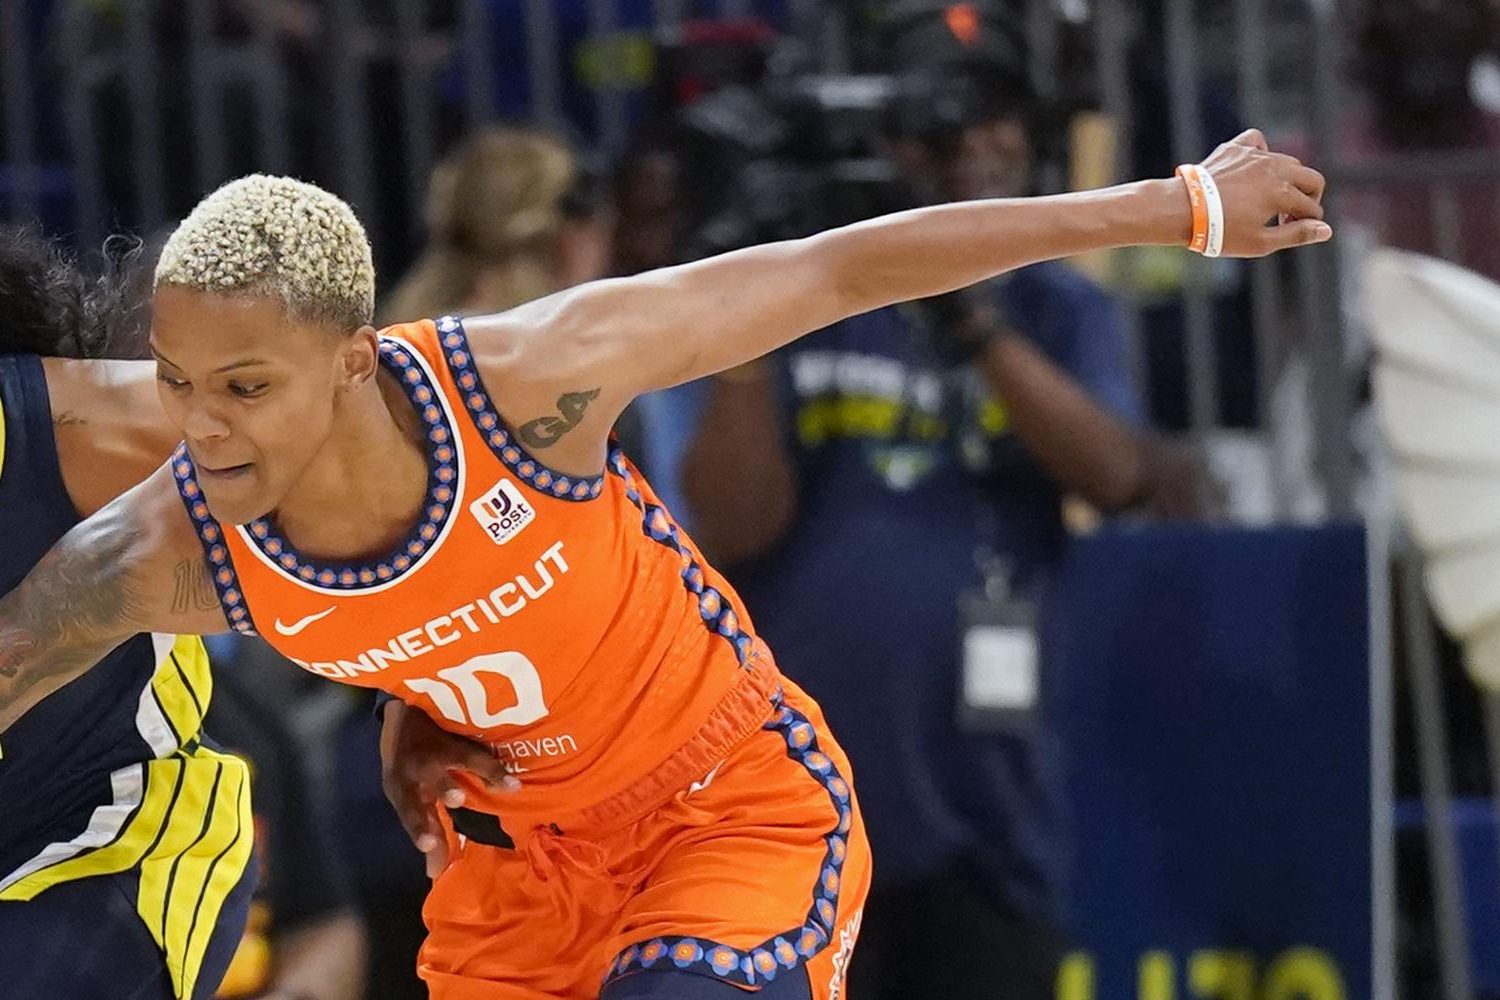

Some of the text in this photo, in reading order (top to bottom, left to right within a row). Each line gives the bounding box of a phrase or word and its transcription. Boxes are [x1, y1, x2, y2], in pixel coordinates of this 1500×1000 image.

[519, 386, 602, 449] GA
[487, 502, 529, 538] Post
[291, 540, 569, 678] CONNECTICUT
[403, 651, 549, 729] 10
